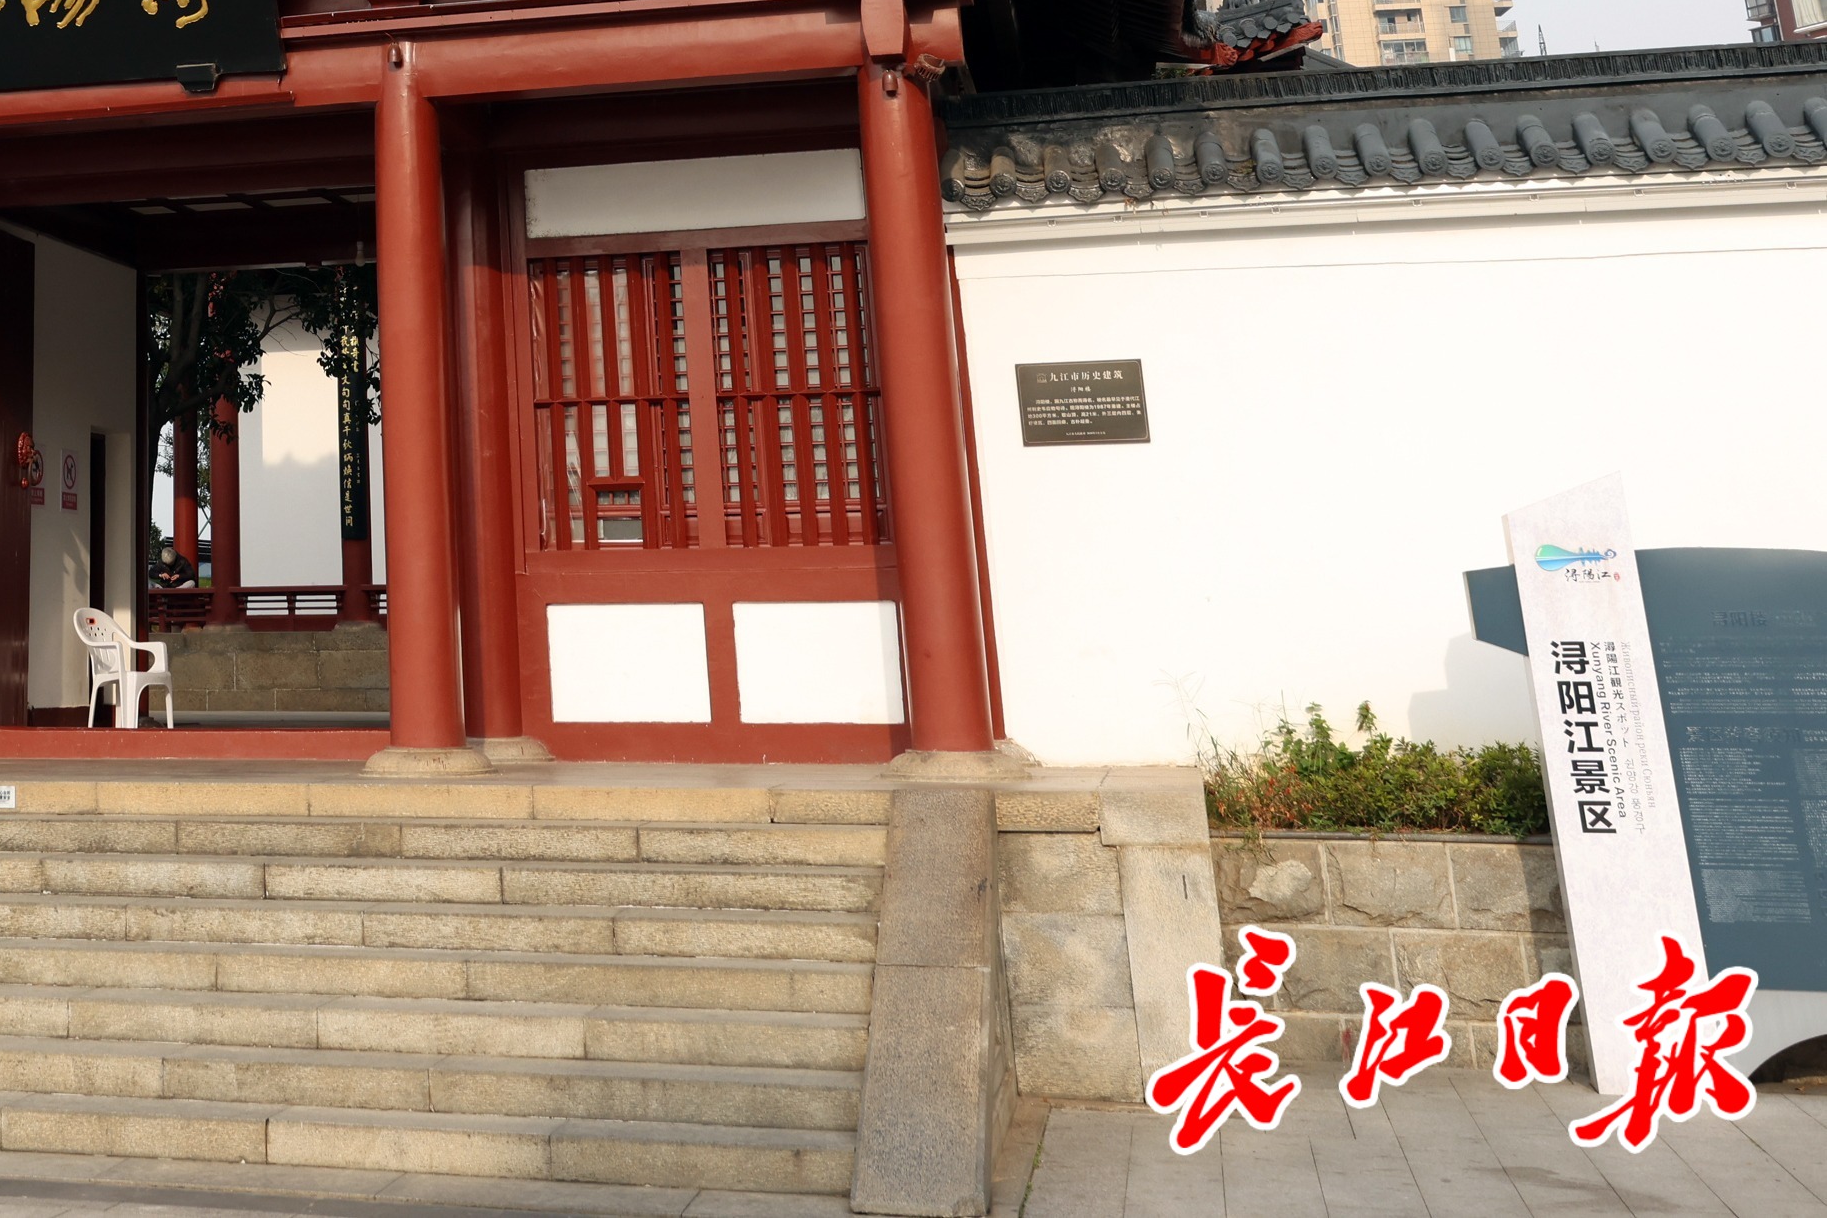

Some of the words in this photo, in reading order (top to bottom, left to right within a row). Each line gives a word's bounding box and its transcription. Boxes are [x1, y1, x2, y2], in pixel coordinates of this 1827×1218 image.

[1050, 370, 1123, 382] 九江市历史建筑
[1550, 640, 1617, 834] 浔阳江景区
[1590, 641, 1607, 699] Xunyang
[1600, 701, 1612, 736] River
[1606, 738, 1622, 784] Scenic
[1614, 787, 1627, 818] Area
